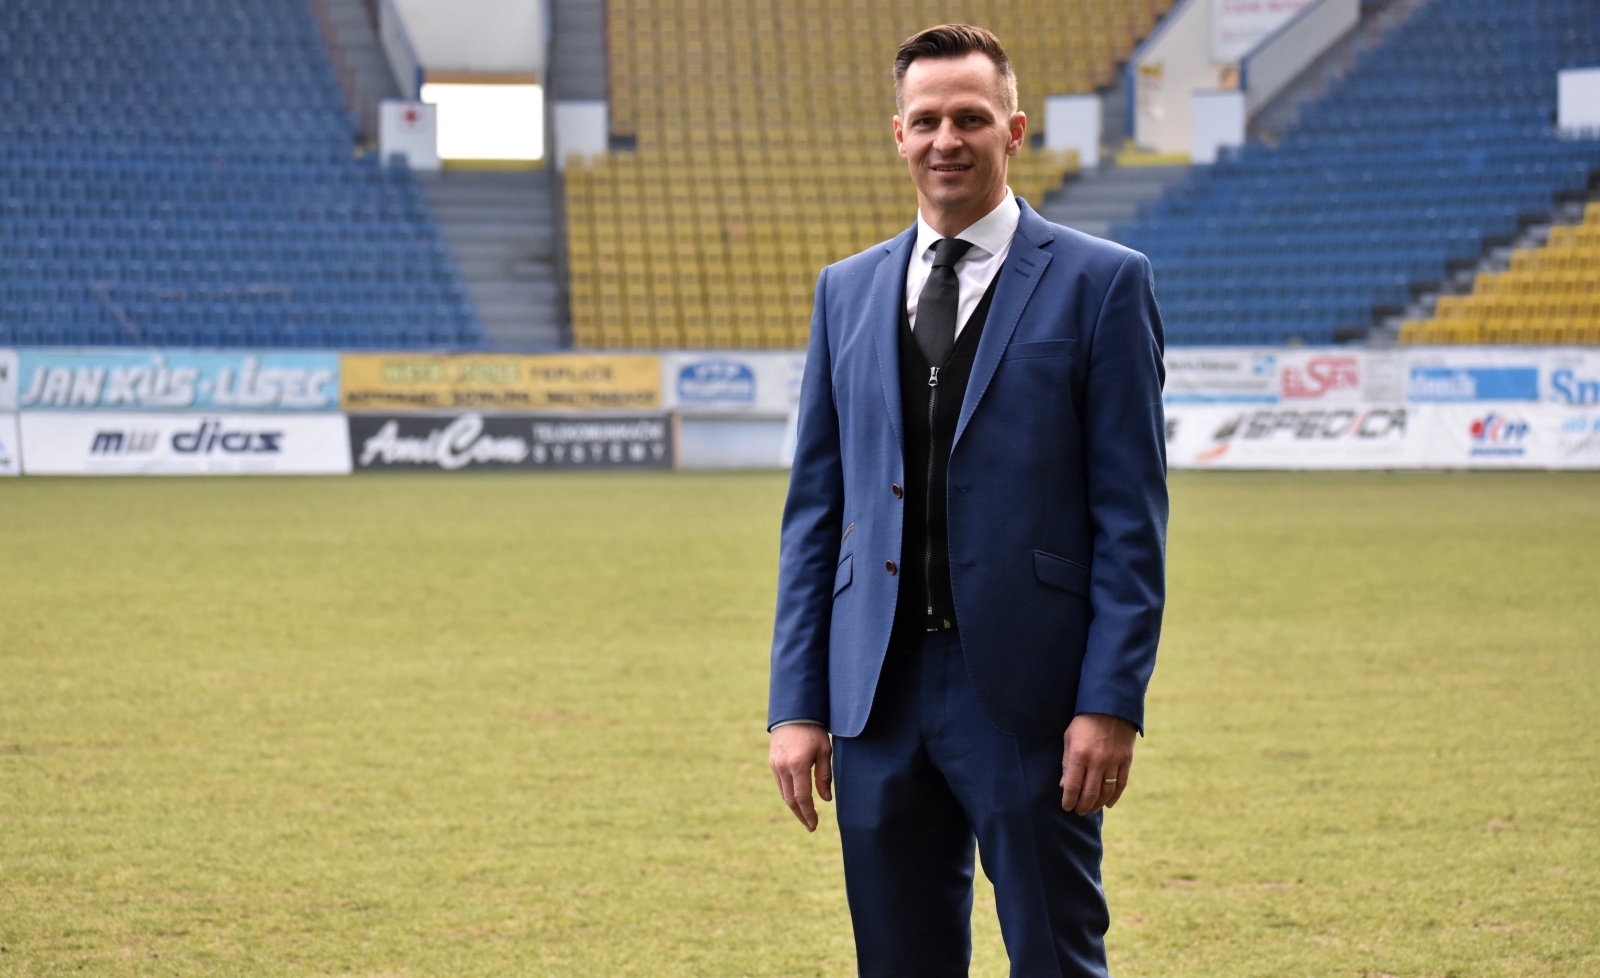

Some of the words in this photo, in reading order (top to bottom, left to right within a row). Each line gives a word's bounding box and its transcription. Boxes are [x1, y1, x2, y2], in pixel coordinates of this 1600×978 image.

[21, 364, 106, 407] JAN
[1281, 357, 1359, 398] ELSEN
[359, 412, 528, 470] AmiCom
